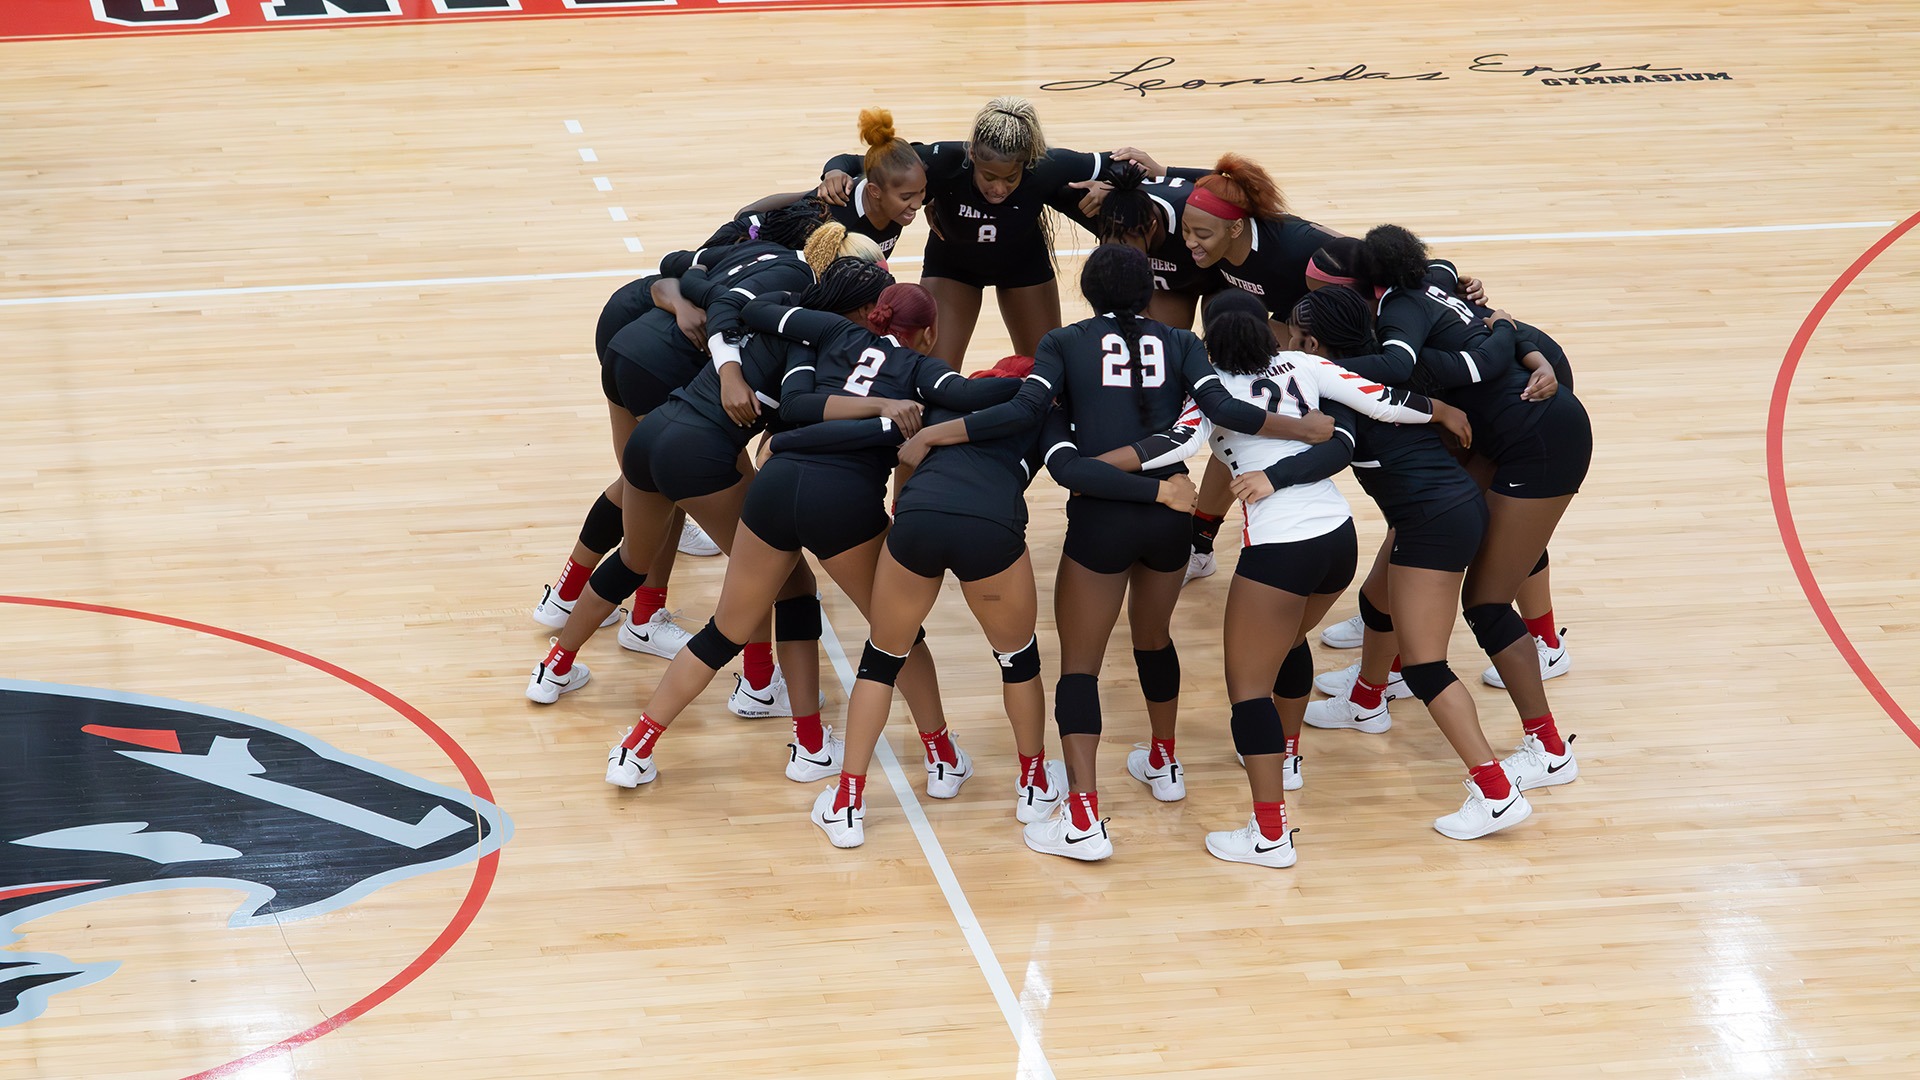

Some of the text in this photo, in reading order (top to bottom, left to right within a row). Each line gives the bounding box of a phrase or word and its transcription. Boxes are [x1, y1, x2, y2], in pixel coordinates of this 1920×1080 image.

[1040, 56, 1450, 97] Leonidas
[1541, 72, 1733, 86] GYMNASIUM
[843, 347, 887, 397] 2
[1101, 333, 1166, 388] 29
[1250, 374, 1311, 417] 21
